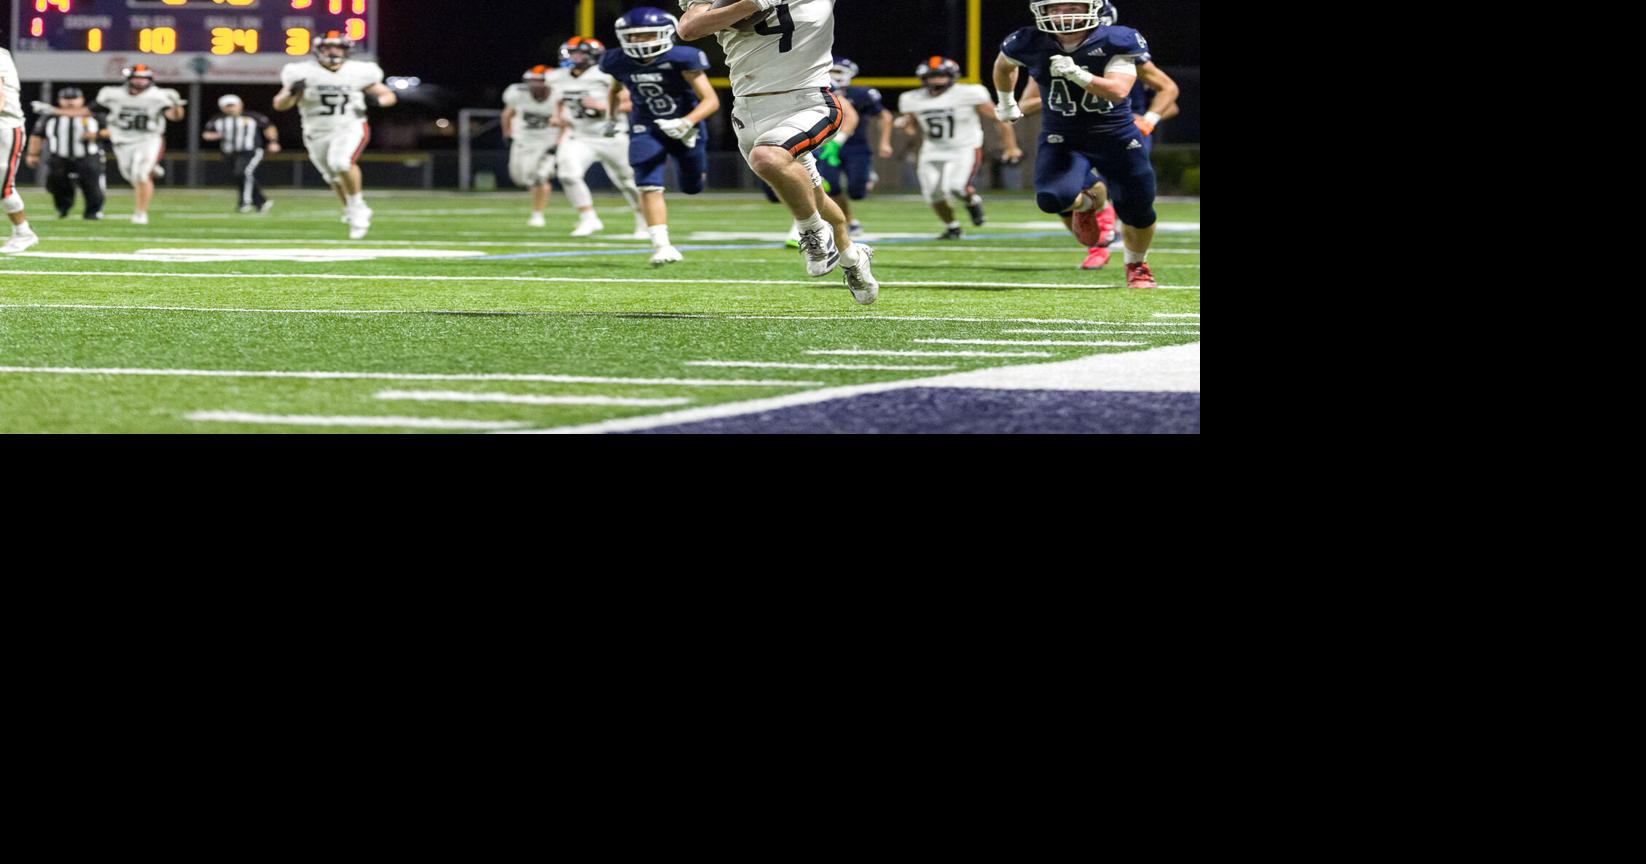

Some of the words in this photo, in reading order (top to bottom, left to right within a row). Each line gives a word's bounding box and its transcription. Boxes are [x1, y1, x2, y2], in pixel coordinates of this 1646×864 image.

[88, 28, 102, 53] 1
[139, 27, 176, 55] 10
[211, 27, 258, 56] 34
[285, 27, 310, 56] 3
[753, 3, 796, 54] 4
[319, 93, 350, 116] 51
[1048, 78, 1114, 117] 44
